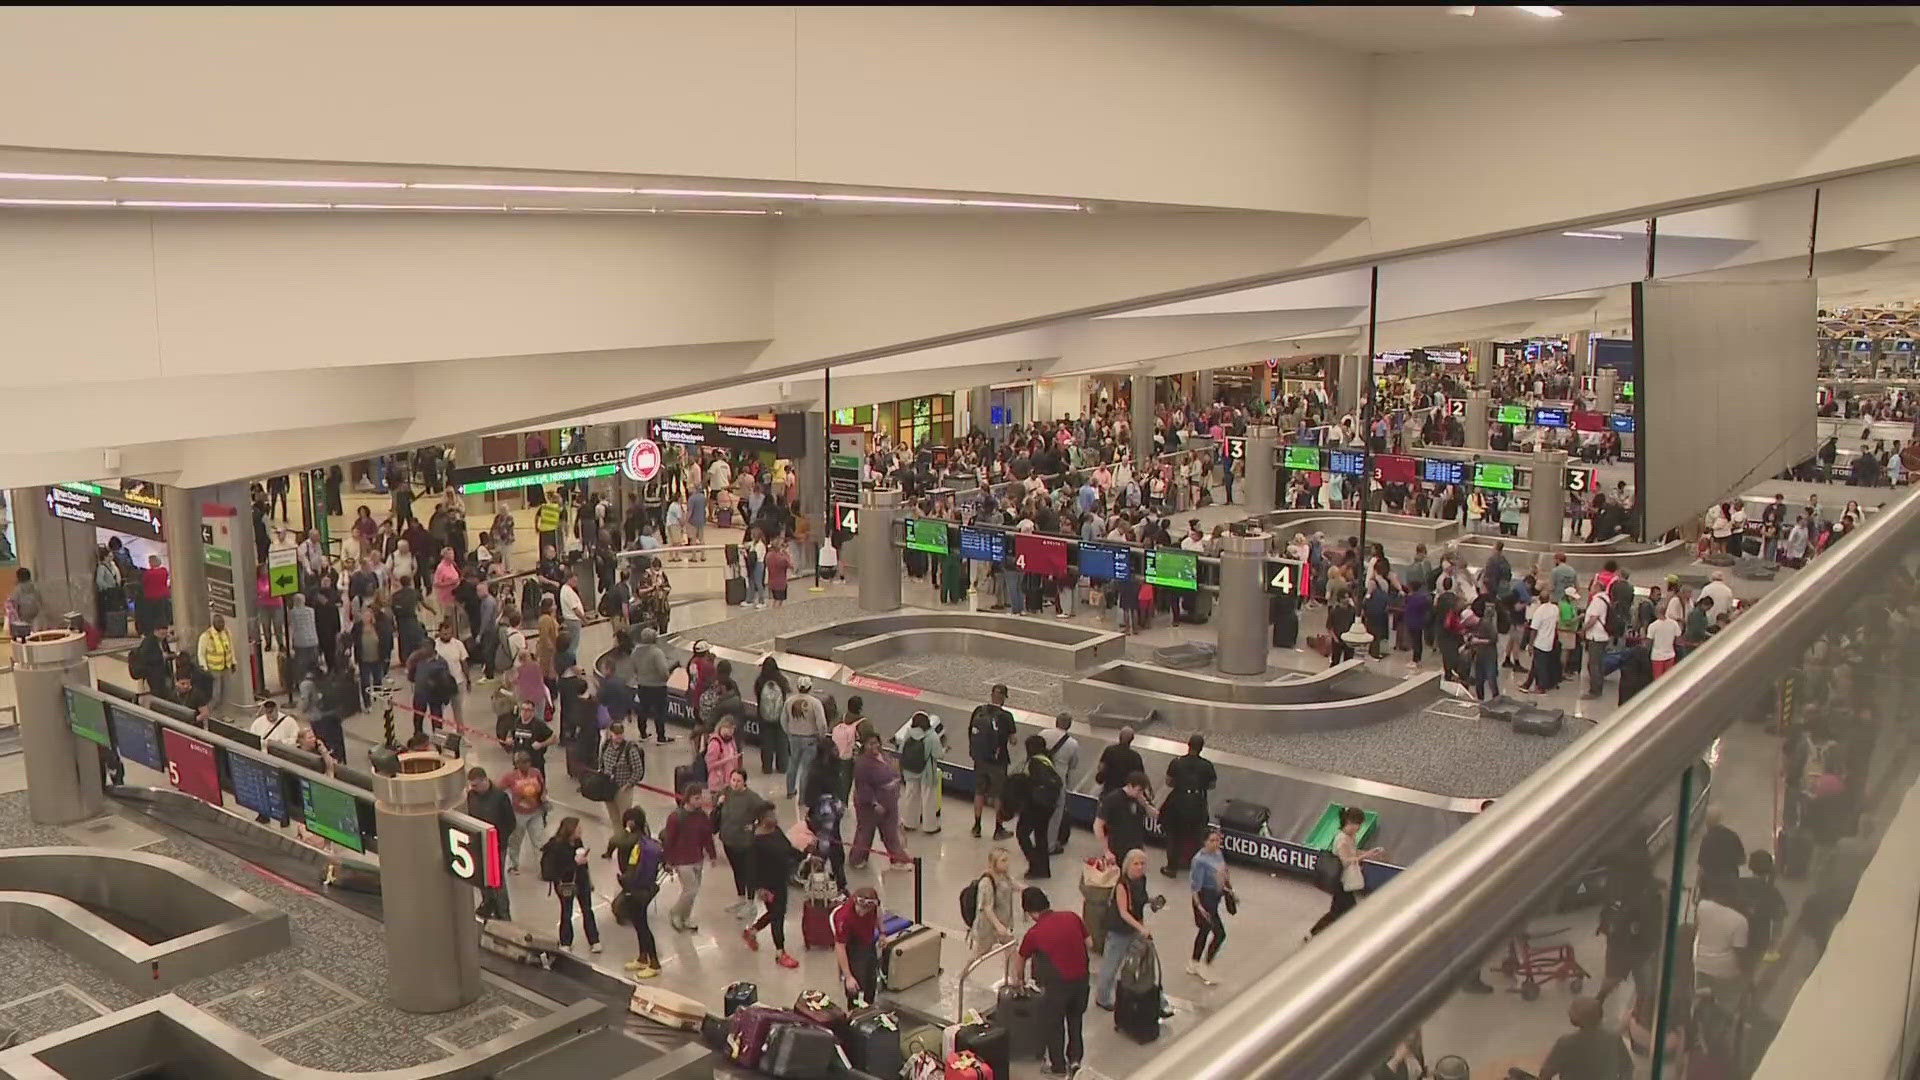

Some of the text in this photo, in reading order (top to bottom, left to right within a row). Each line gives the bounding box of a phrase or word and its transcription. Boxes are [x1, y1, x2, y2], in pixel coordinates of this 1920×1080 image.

[1453, 402, 1463, 415] 2
[1570, 421, 1577, 430] 2
[1231, 441, 1243, 458] 3
[490, 462, 529, 475] SOUTH
[535, 454, 588, 469] BAGGAGE
[593, 450, 626, 462] CLAIM
[1374, 468, 1382, 479] 3
[1569, 470, 1585, 490] 3
[842, 509, 858, 533] 4
[1016, 555, 1026, 569] 4
[1271, 566, 1293, 594] 4
[667, 701, 685, 716] ATL,
[168, 761, 180, 785] 5
[448, 828, 475, 878] 5
[1260, 843, 1288, 864] BAG
[1290, 850, 1318, 870] FLIE
